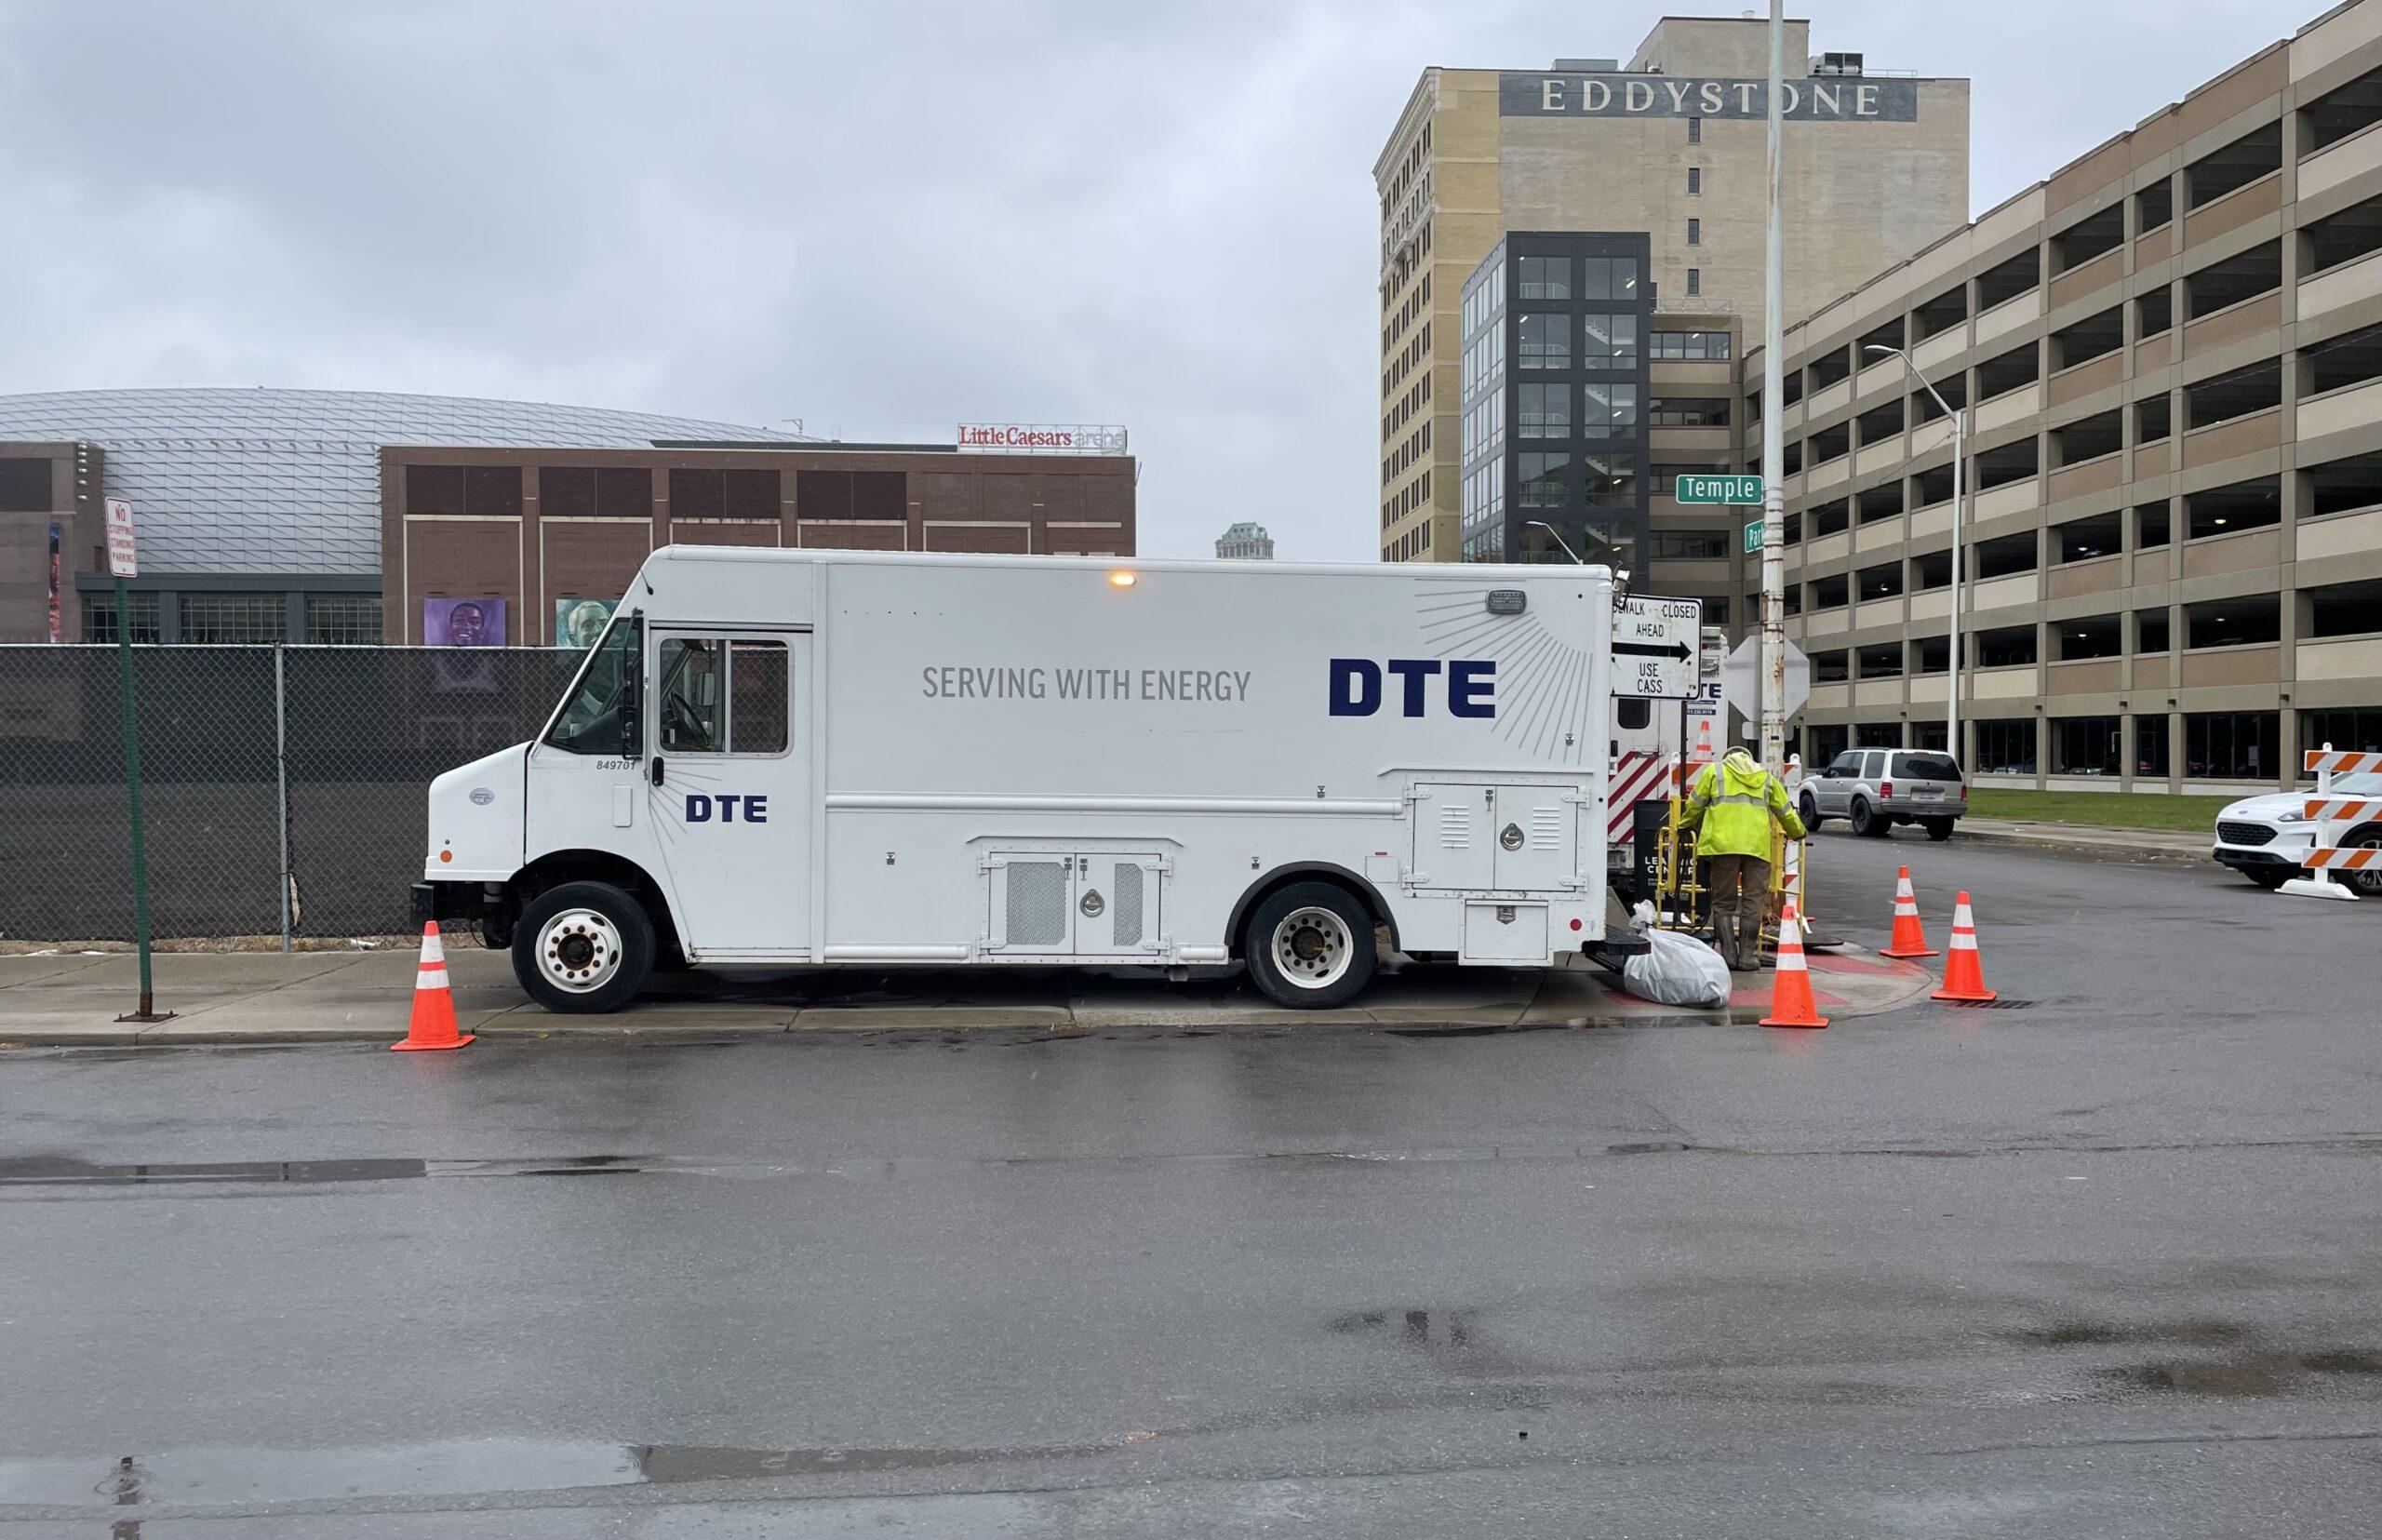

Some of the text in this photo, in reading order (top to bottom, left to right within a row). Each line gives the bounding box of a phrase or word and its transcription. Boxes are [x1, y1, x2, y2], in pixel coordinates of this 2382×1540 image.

[1542, 80, 1880, 115] EDDYSTONE
[959, 426, 1004, 445] Little
[1006, 427, 1072, 446] Caesars
[1686, 477, 1755, 502] Temple
[115, 507, 126, 522] NO
[113, 551, 134, 564] PARKING
[1613, 600, 1696, 619] DEWALK CLOSED
[1636, 623, 1664, 637] AHEAD
[1639, 663, 1659, 677] USE
[922, 667, 1251, 702] SERVING WITH ENERGY
[1329, 658, 1496, 718] DTE
[1637, 678, 1663, 693] CASS
[1700, 683, 1721, 698] TE
[686, 795, 768, 823] DTE
[1644, 856, 1698, 866] LEAG
